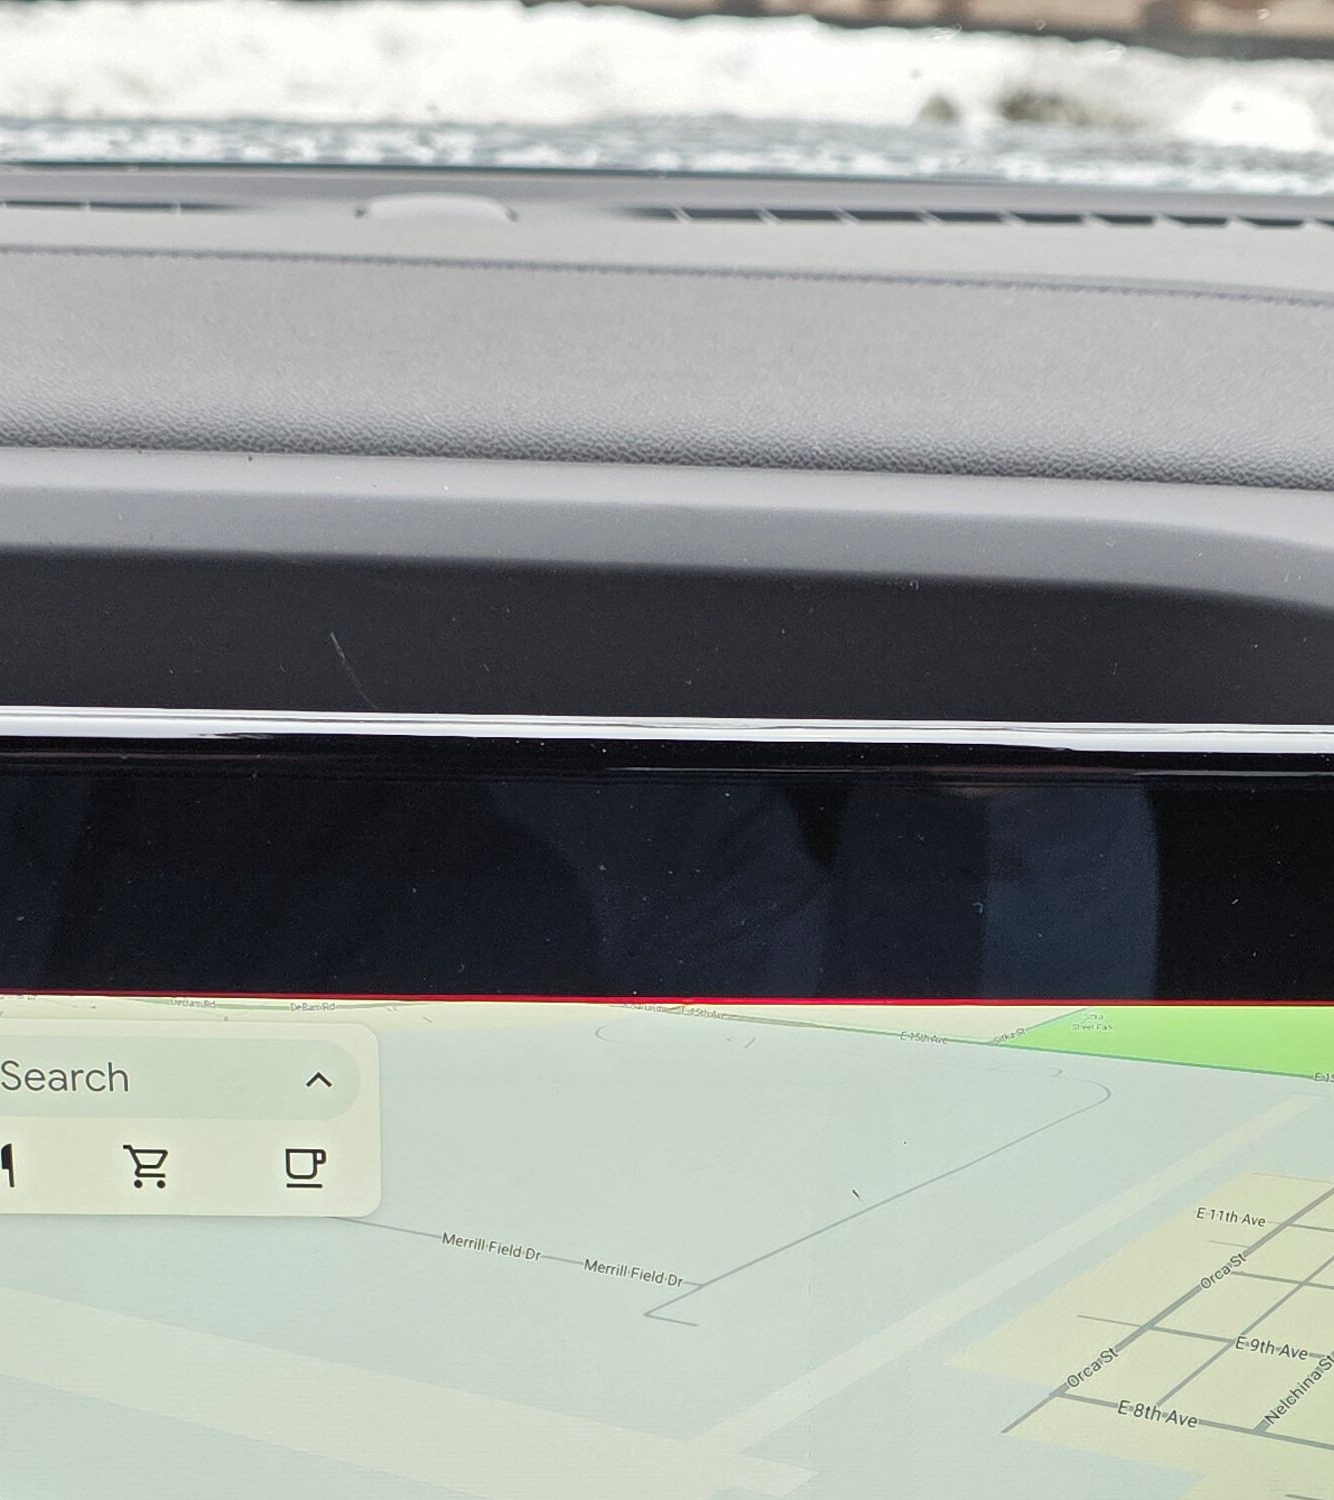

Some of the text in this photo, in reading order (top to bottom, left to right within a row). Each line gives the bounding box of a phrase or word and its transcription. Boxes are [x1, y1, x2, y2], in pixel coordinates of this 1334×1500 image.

[1196, 1207, 1266, 1228] E 11th Ave
[441, 1231, 542, 1262] Merrill Field Dr
[584, 1257, 684, 1288] Merrill Field Dr
[1200, 1252, 1247, 1290] Orca St
[1235, 1336, 1309, 1361] E 9th Ave
[1066, 1347, 1119, 1388] Orca St
[1264, 1369, 1321, 1426] Nelchina
[1117, 1400, 1199, 1428] E 8th Ave
